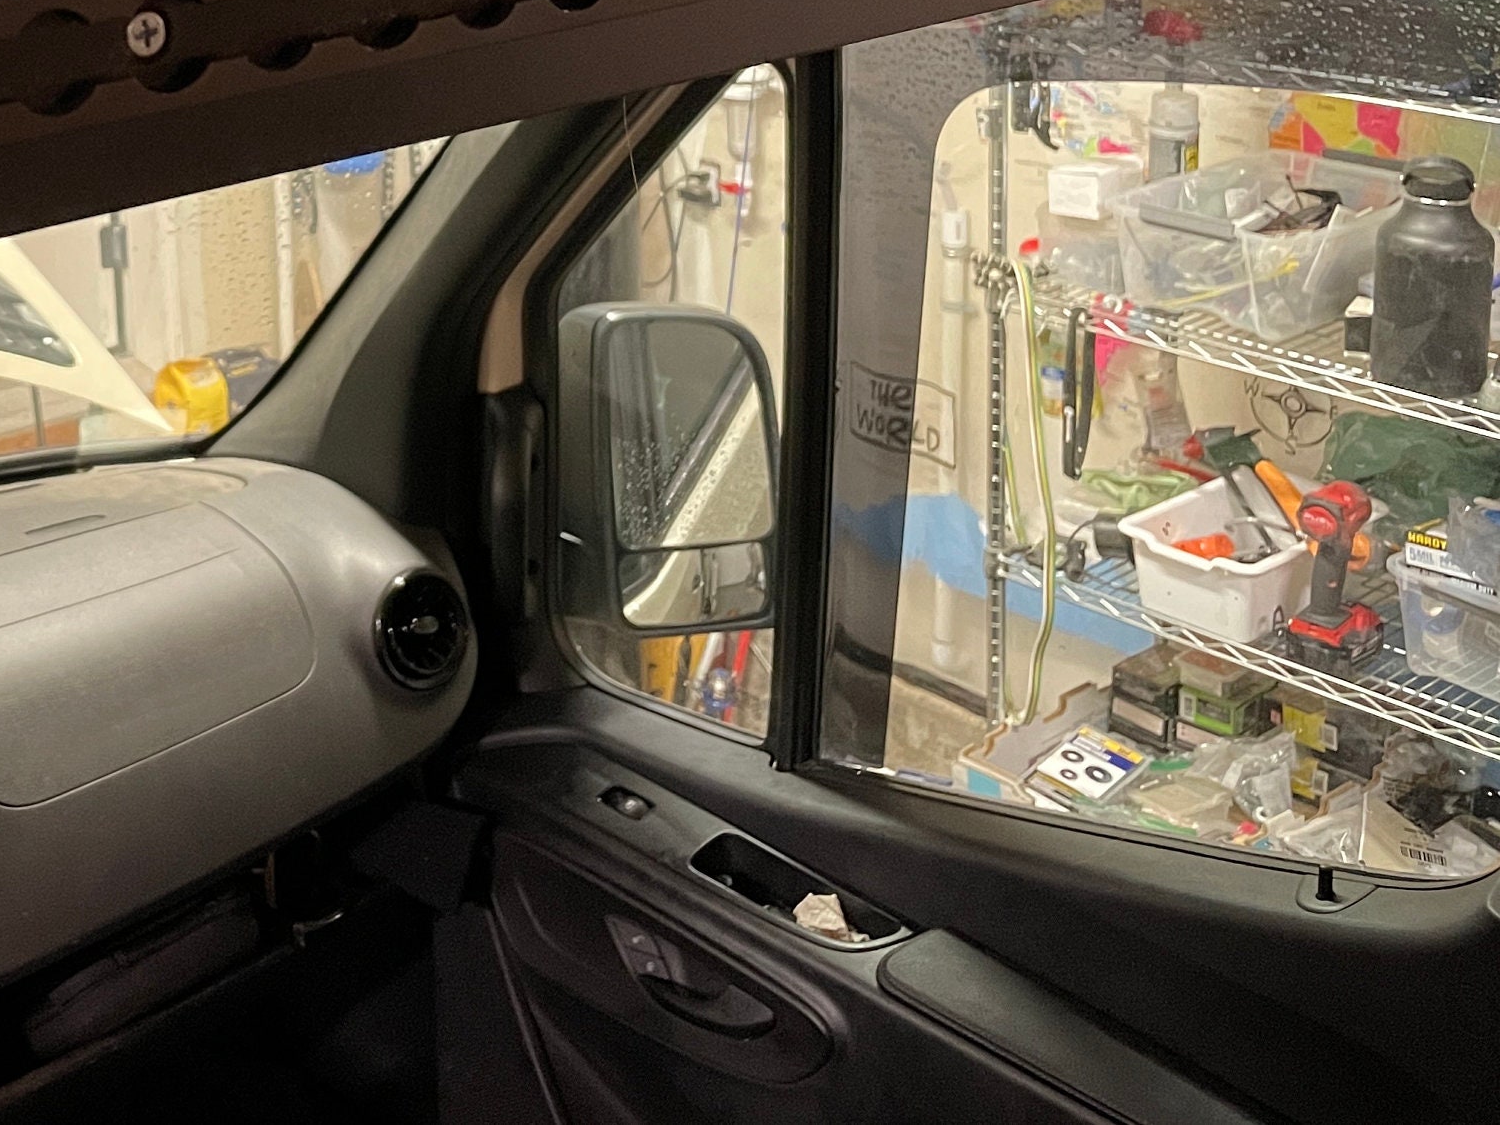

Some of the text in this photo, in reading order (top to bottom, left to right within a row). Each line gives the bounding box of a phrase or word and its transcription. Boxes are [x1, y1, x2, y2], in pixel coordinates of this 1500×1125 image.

[1243, 376, 1260, 397] W
[856, 403, 940, 452] WORLD
[1284, 434, 1298, 456] S
[1407, 530, 1448, 551] HARDY
